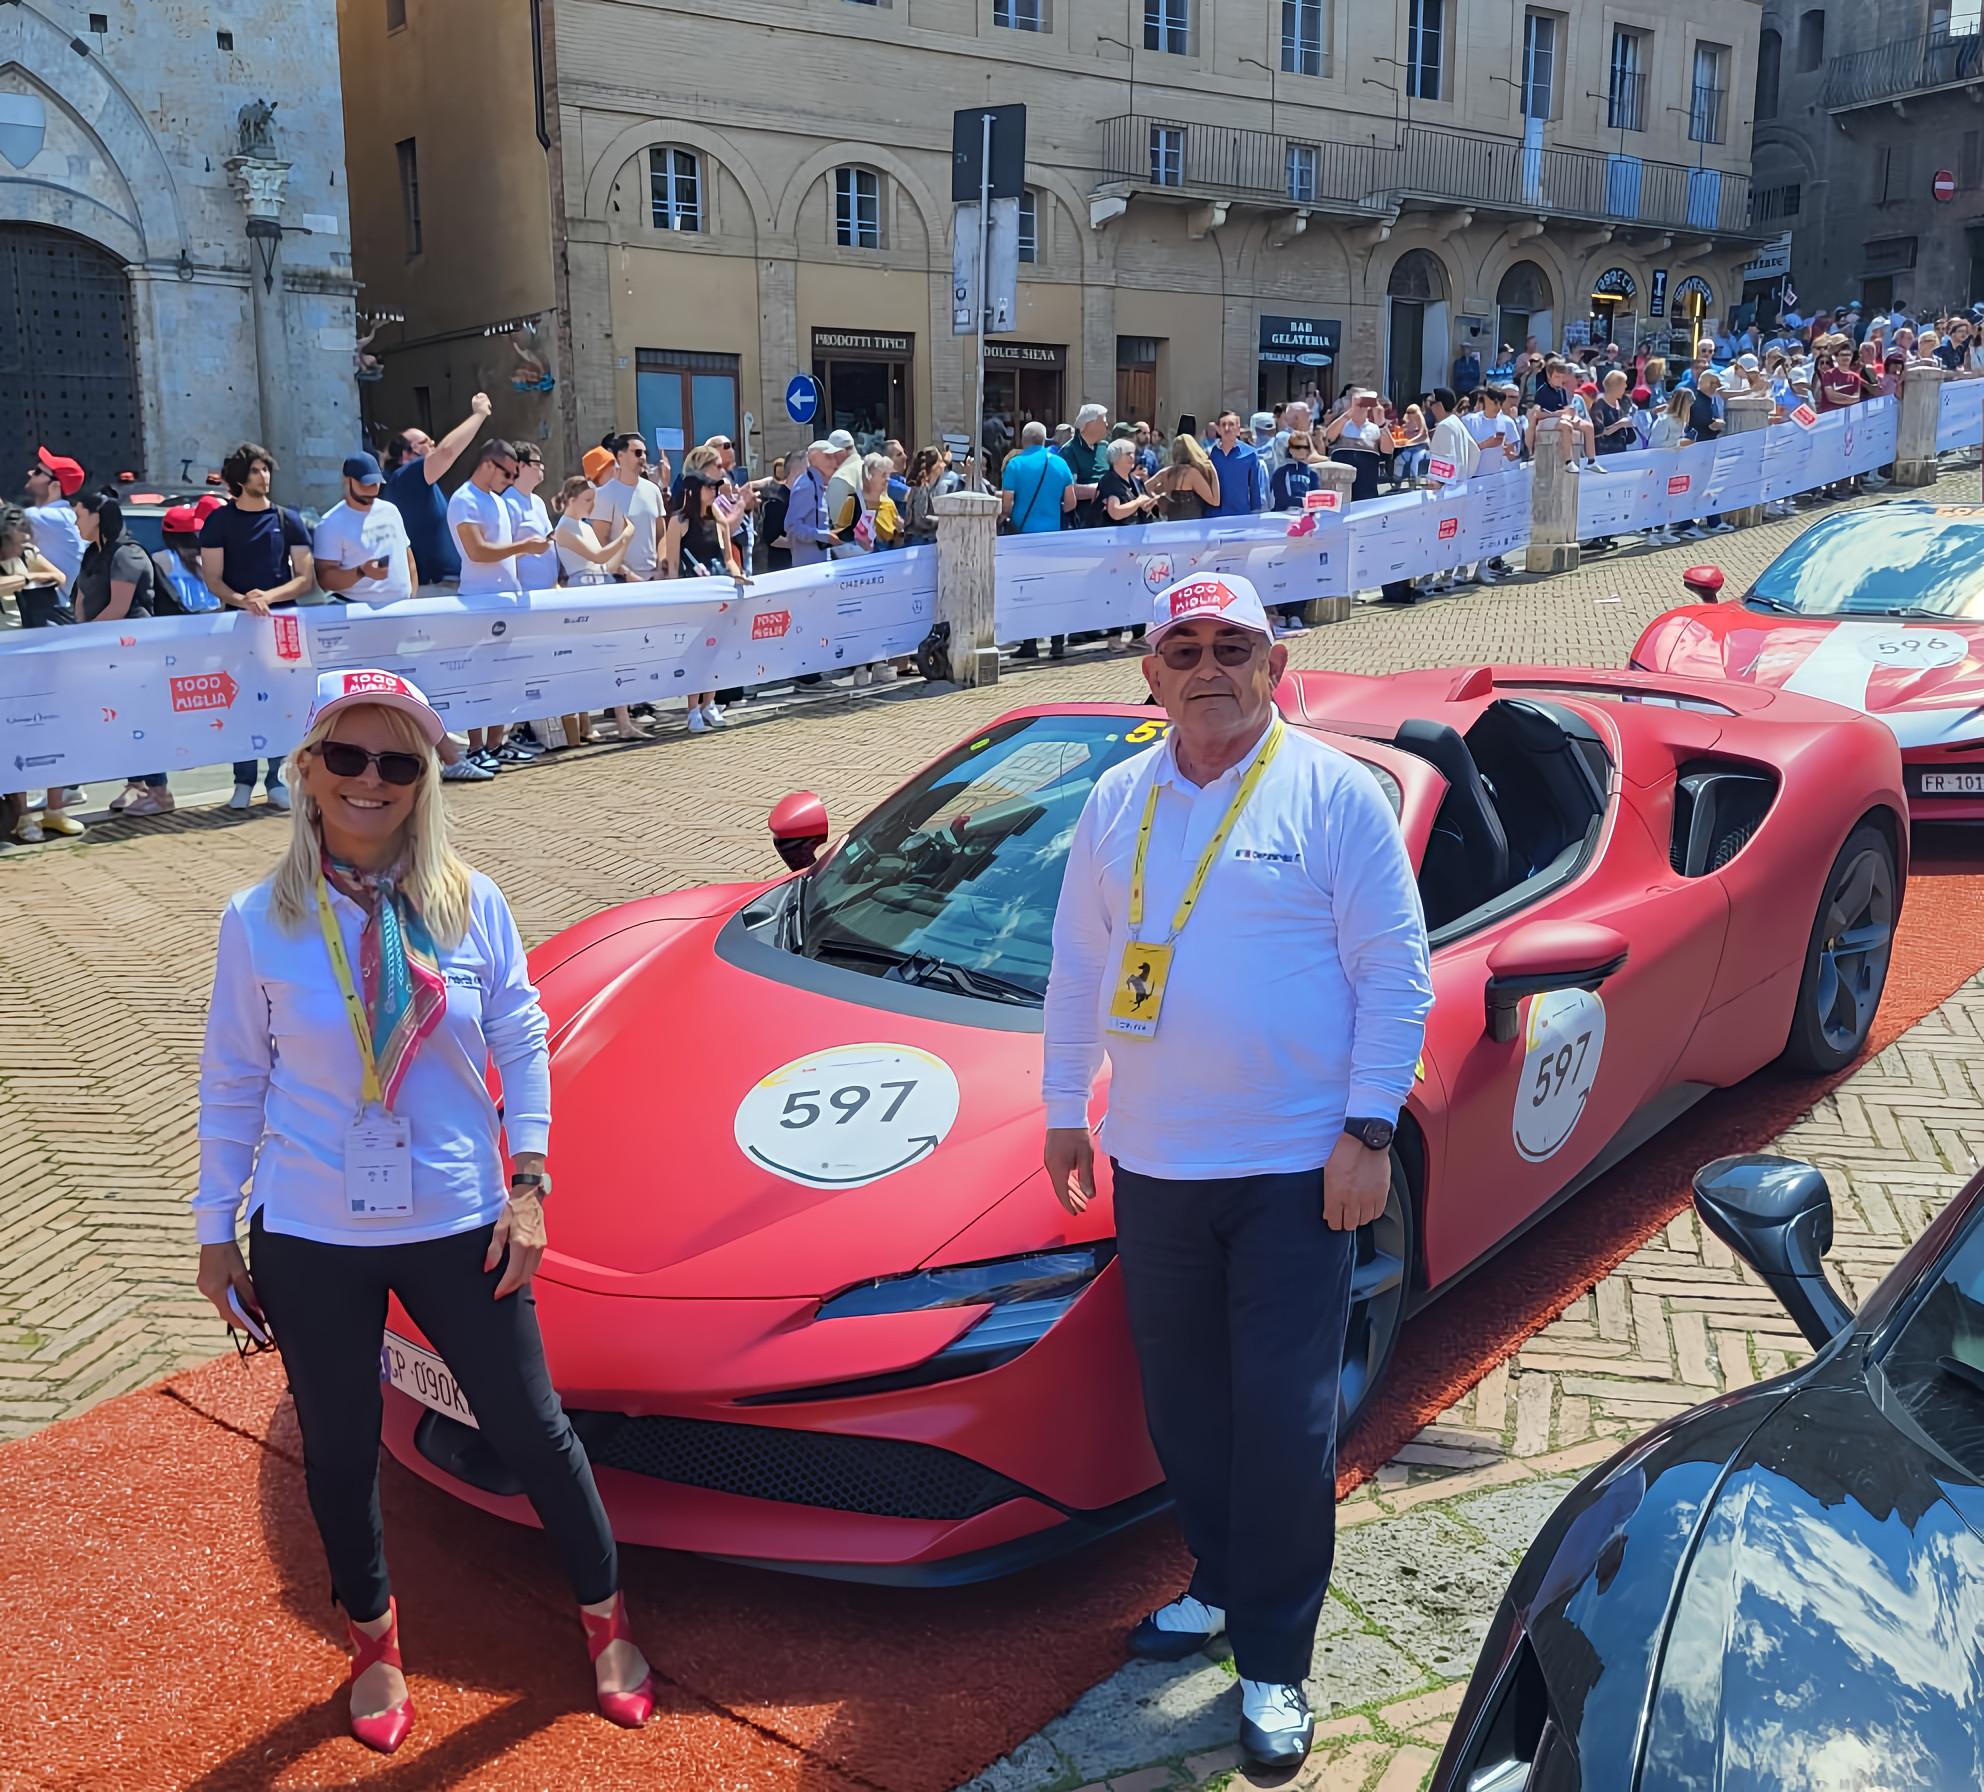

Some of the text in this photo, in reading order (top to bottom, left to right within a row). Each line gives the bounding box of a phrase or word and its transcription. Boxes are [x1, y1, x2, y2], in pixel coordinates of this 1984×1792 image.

[1179, 585, 1217, 598] 1000
[1878, 638, 1949, 655] 596
[176, 677, 221, 692] 1000
[352, 674, 397, 686] 1000
[176, 692, 227, 710] MIGLIA
[1125, 720, 1169, 743] 5
[1532, 1031, 1593, 1107] 597
[779, 1080, 919, 1129] 597
